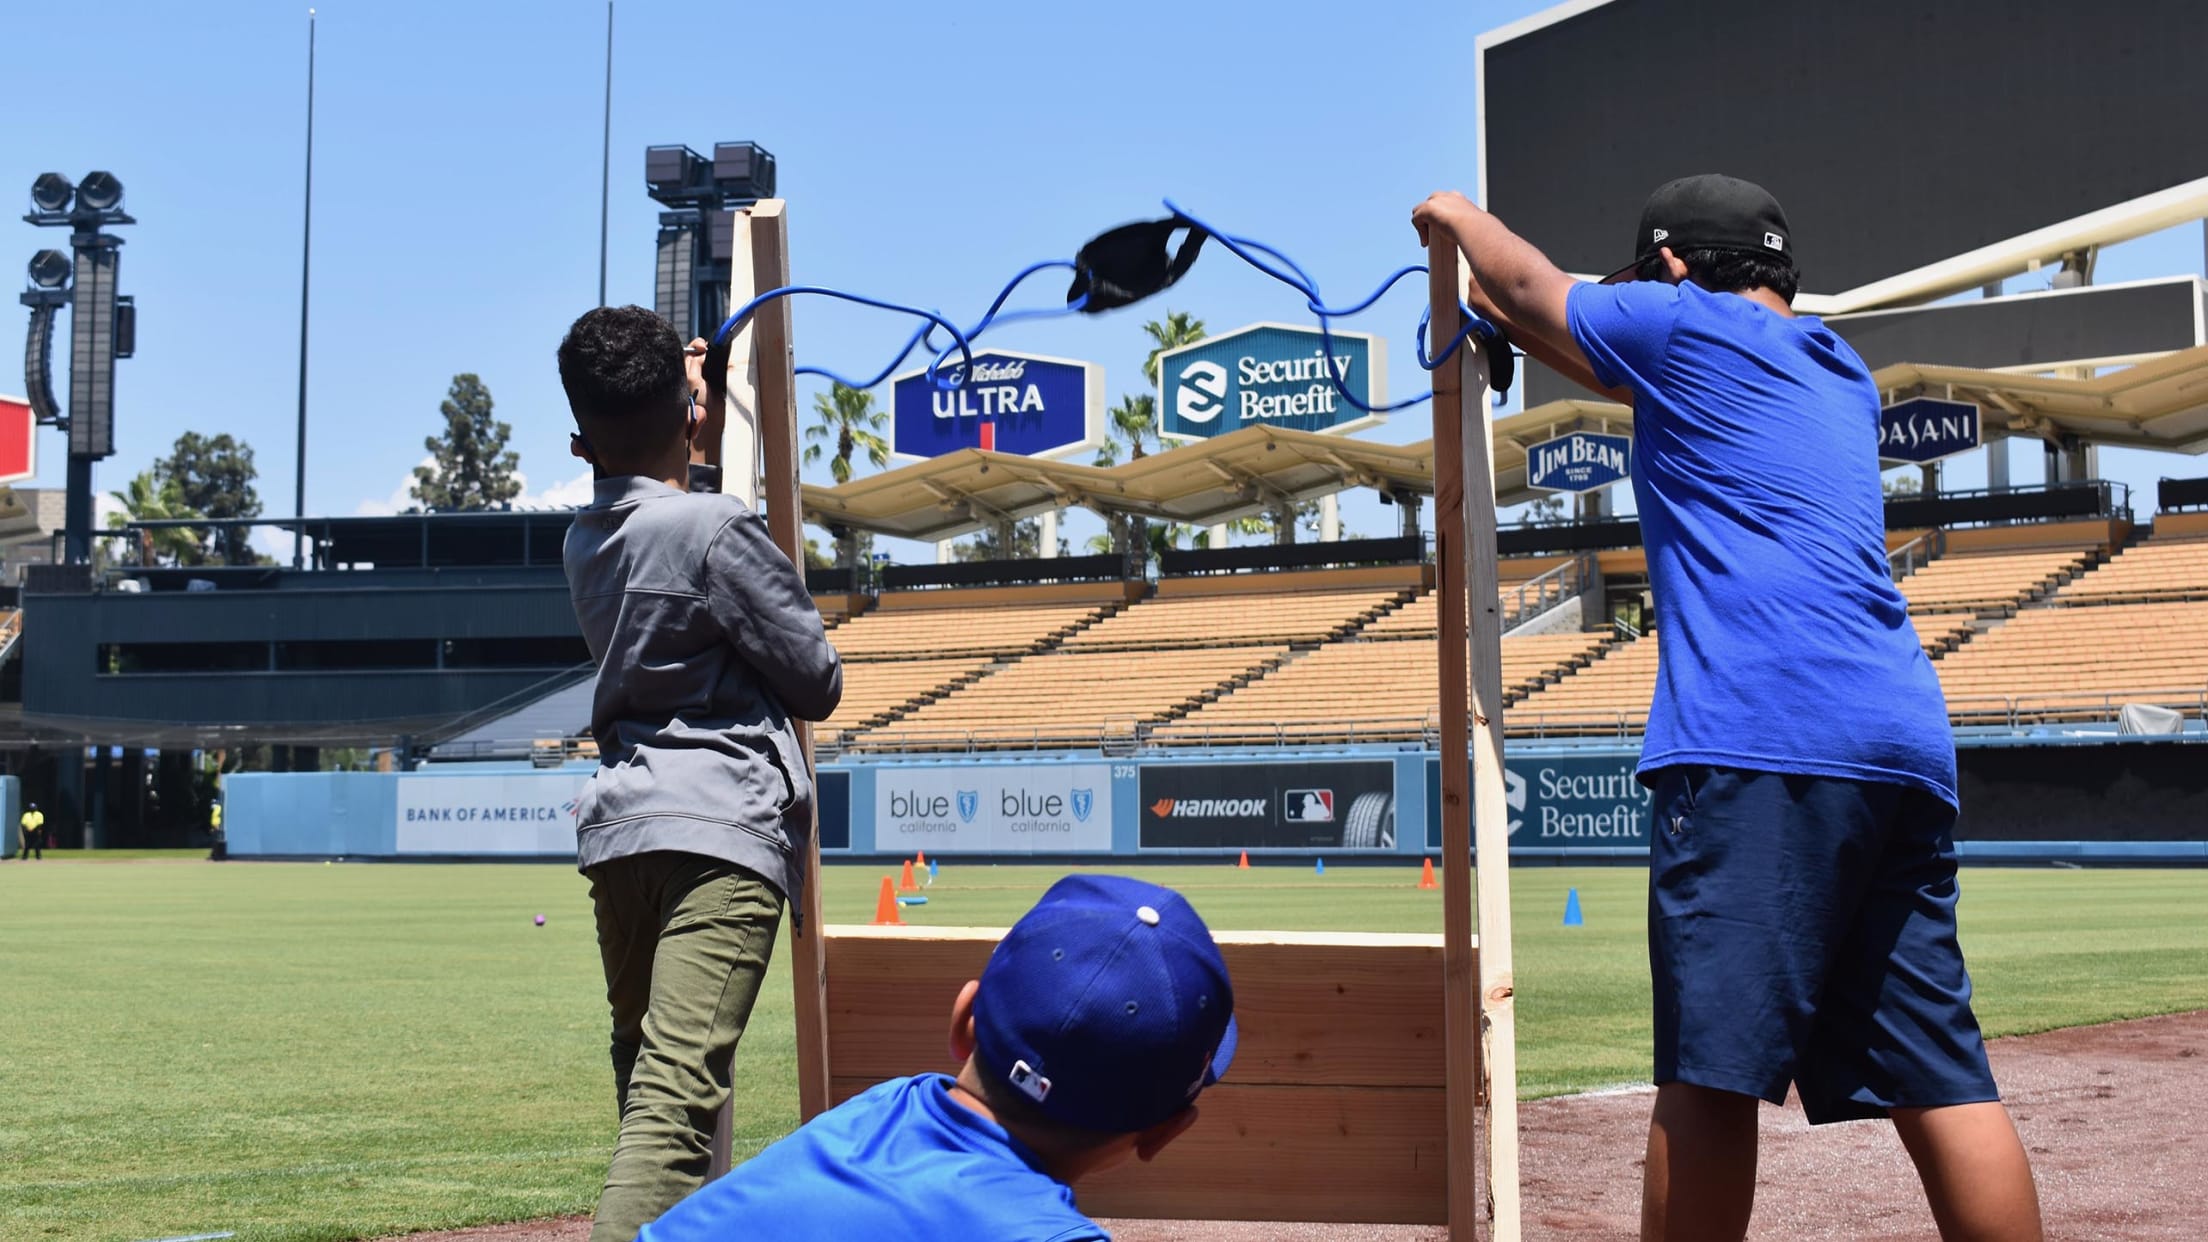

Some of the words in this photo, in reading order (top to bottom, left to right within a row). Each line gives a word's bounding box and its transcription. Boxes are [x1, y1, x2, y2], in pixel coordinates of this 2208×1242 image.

[1238, 350, 1352, 386] Security
[932, 384, 1045, 419] ULTRA
[1239, 384, 1337, 419] Benefit
[1532, 447, 1568, 485] JIM
[1571, 436, 1625, 477] BEAM
[1114, 765, 1136, 779] 375
[406, 808, 451, 822] BANK
[457, 808, 477, 822] OF
[481, 807, 557, 821] AMERICA
[890, 789, 950, 818] blue
[1001, 788, 1063, 817] blue
[899, 820, 957, 833] california
[1011, 819, 1071, 833] california
[1540, 805, 1642, 837] Benefit
